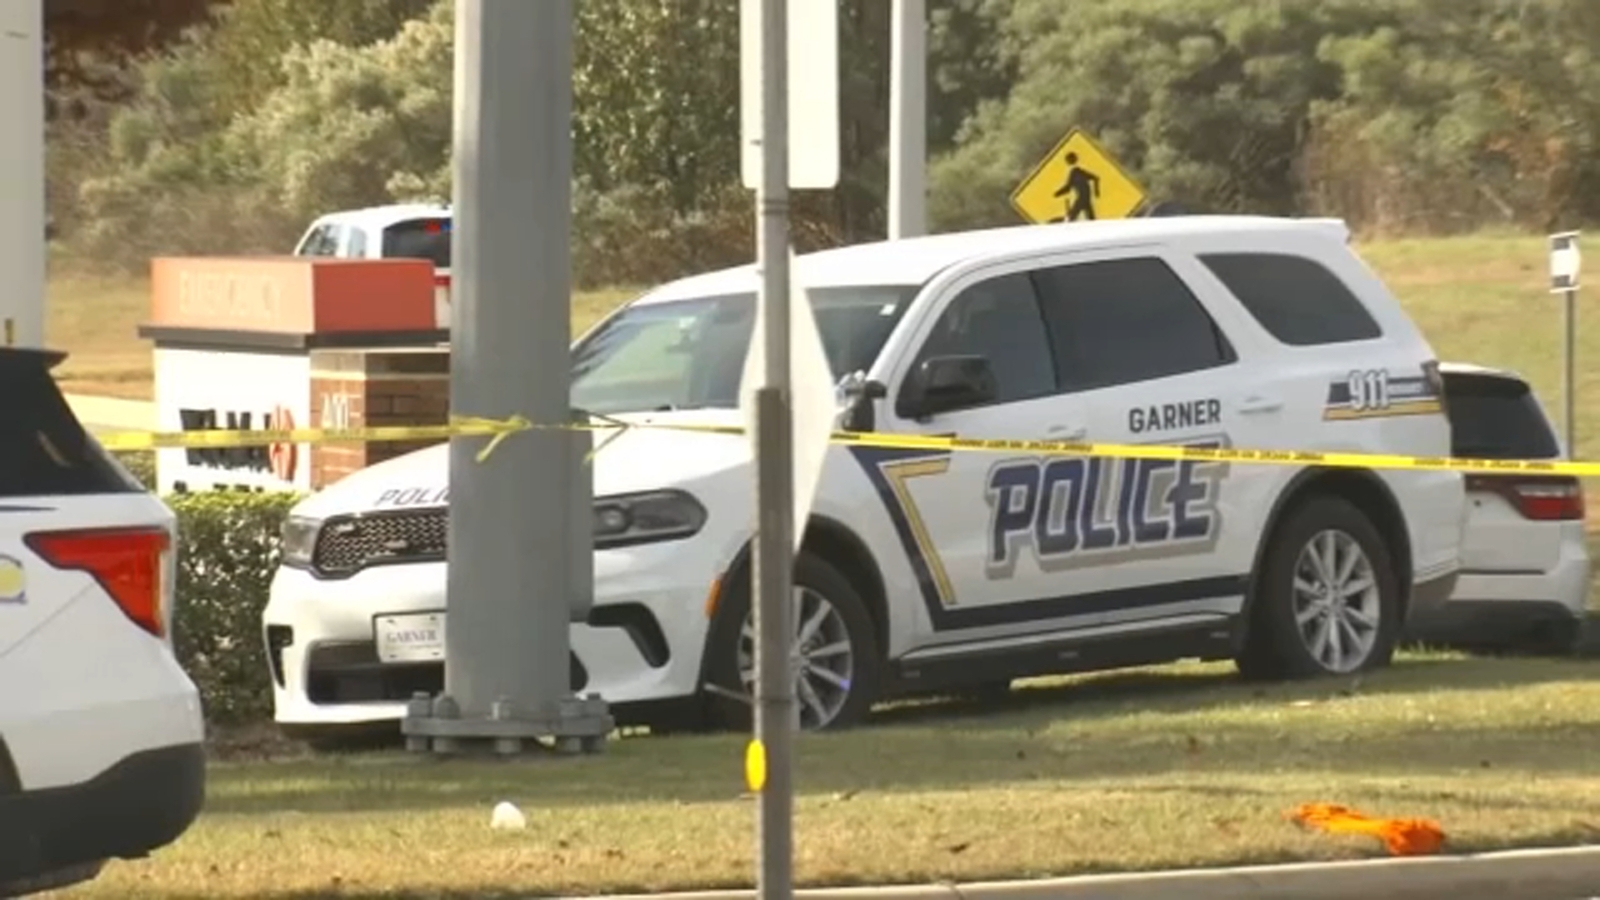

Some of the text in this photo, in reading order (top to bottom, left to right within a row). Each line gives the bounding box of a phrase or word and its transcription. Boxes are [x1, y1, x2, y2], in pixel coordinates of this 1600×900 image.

[1348, 369, 1390, 411] 911
[1129, 399, 1221, 433] GARNER
[987, 437, 1227, 572] POLICE
